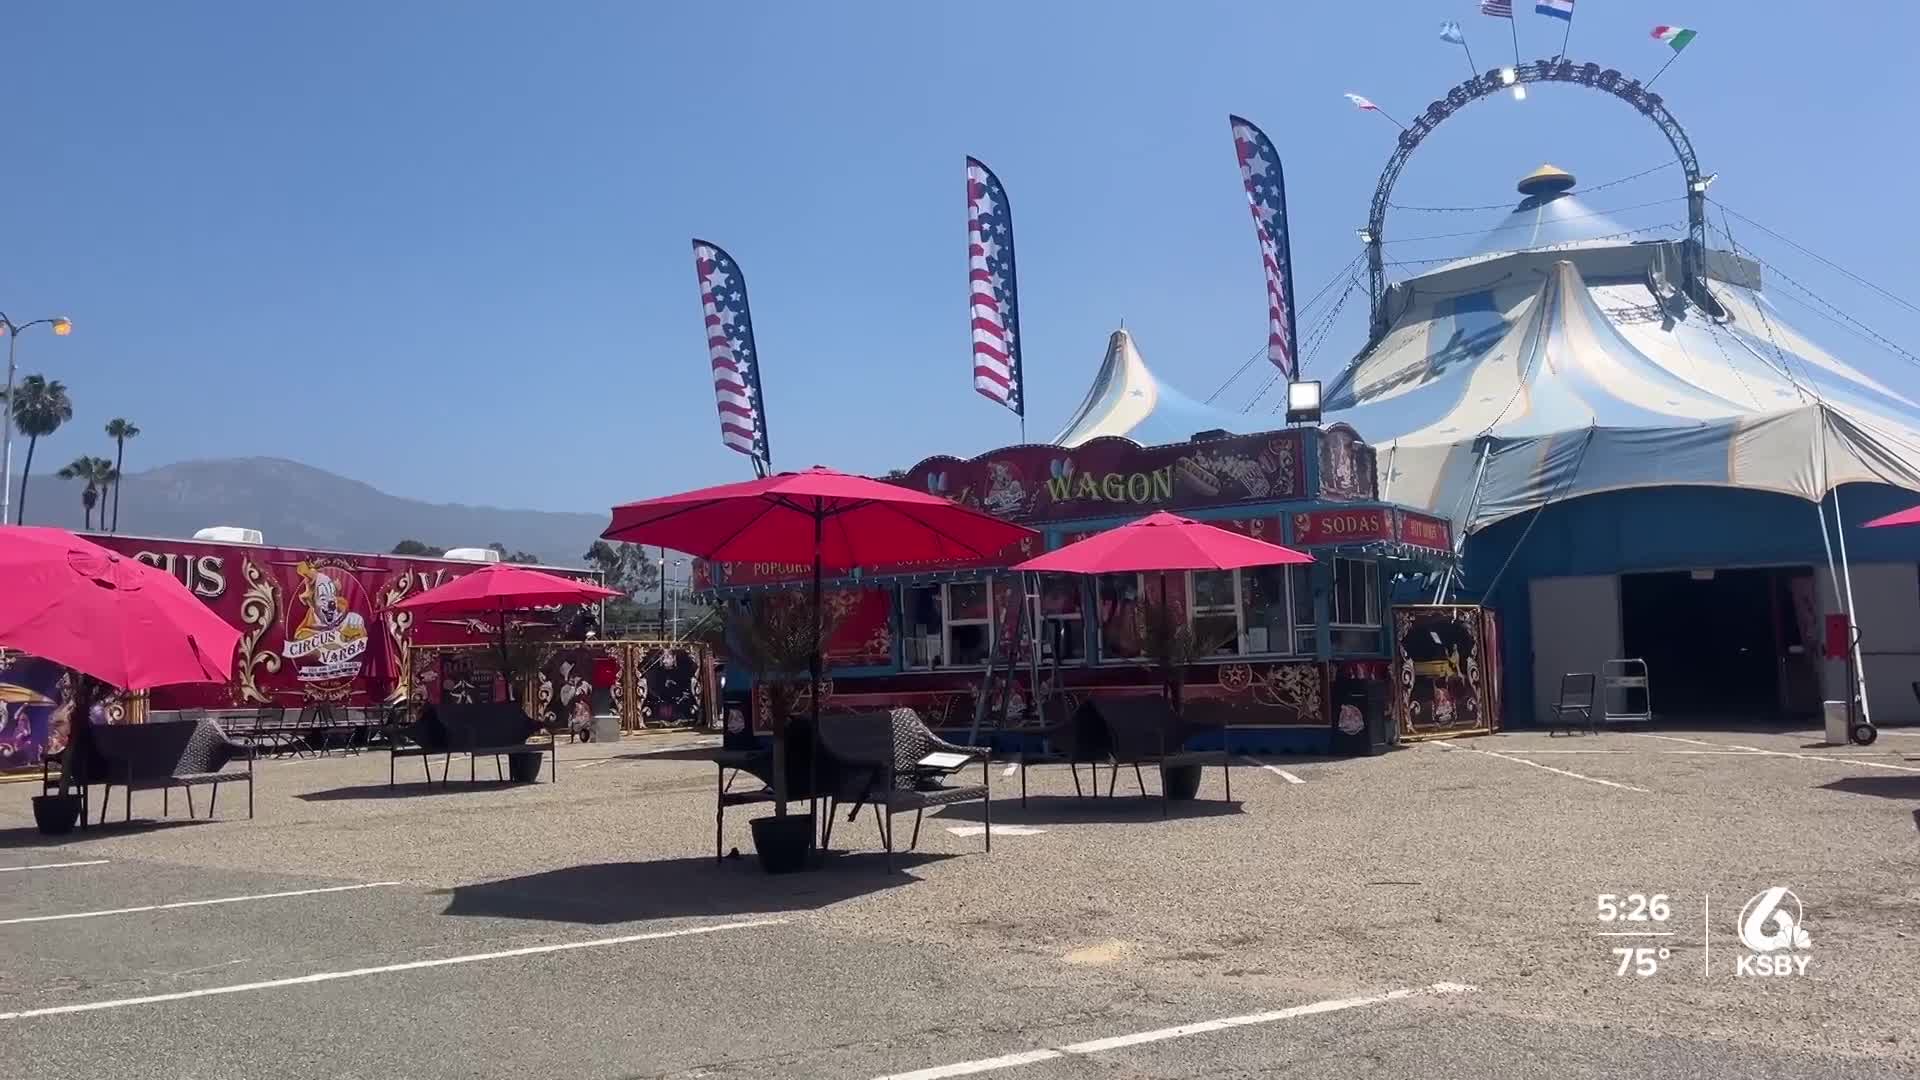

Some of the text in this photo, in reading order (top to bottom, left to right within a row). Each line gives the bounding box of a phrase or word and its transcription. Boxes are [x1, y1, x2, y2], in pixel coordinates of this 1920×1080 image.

[1047, 465, 1174, 503] WAGON
[1321, 515, 1379, 534] SODAS
[289, 631, 336, 656] CIRCUS
